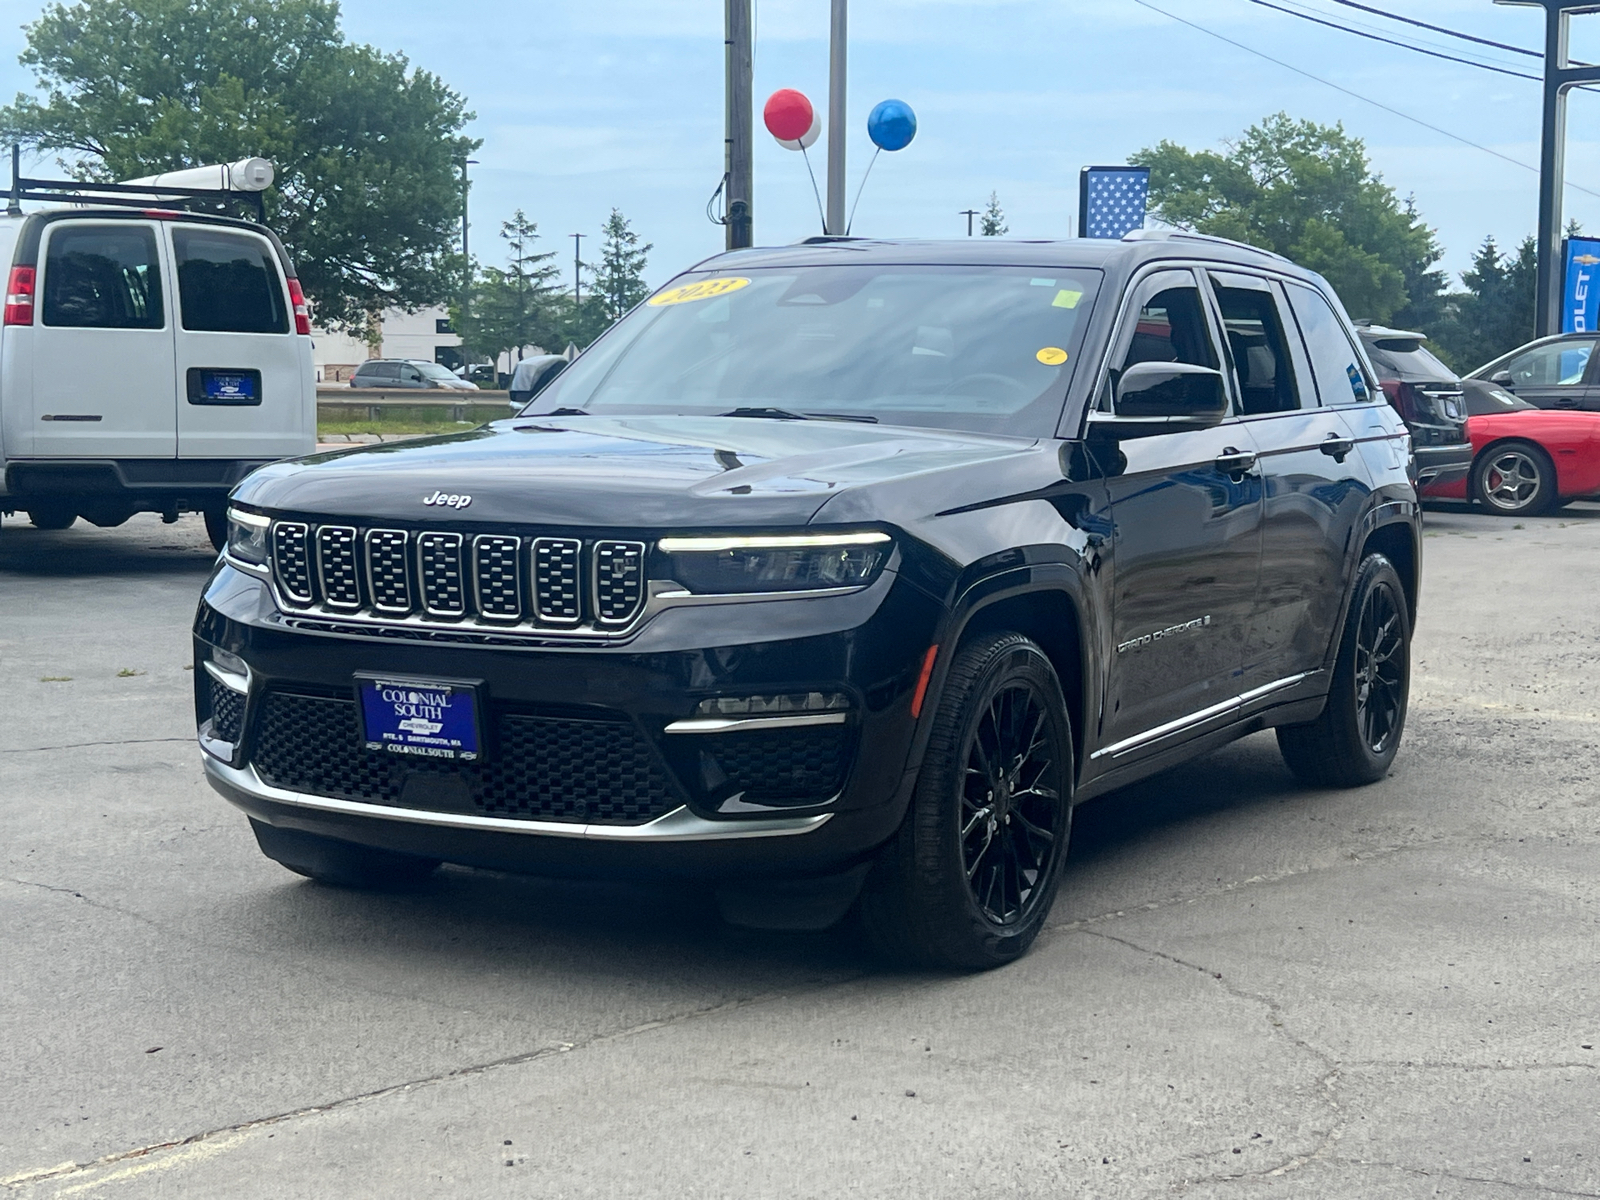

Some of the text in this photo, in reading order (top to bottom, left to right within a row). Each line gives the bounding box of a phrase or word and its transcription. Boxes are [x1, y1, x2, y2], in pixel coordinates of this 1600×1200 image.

[657, 279, 738, 304] 2023
[423, 490, 472, 510] Jeep
[1117, 618, 1203, 653] GRAND CHEROKEE
[382, 689, 452, 708] COLONIAL
[394, 704, 442, 720] SOUTH
[402, 722, 439, 731] CHEVROLET
